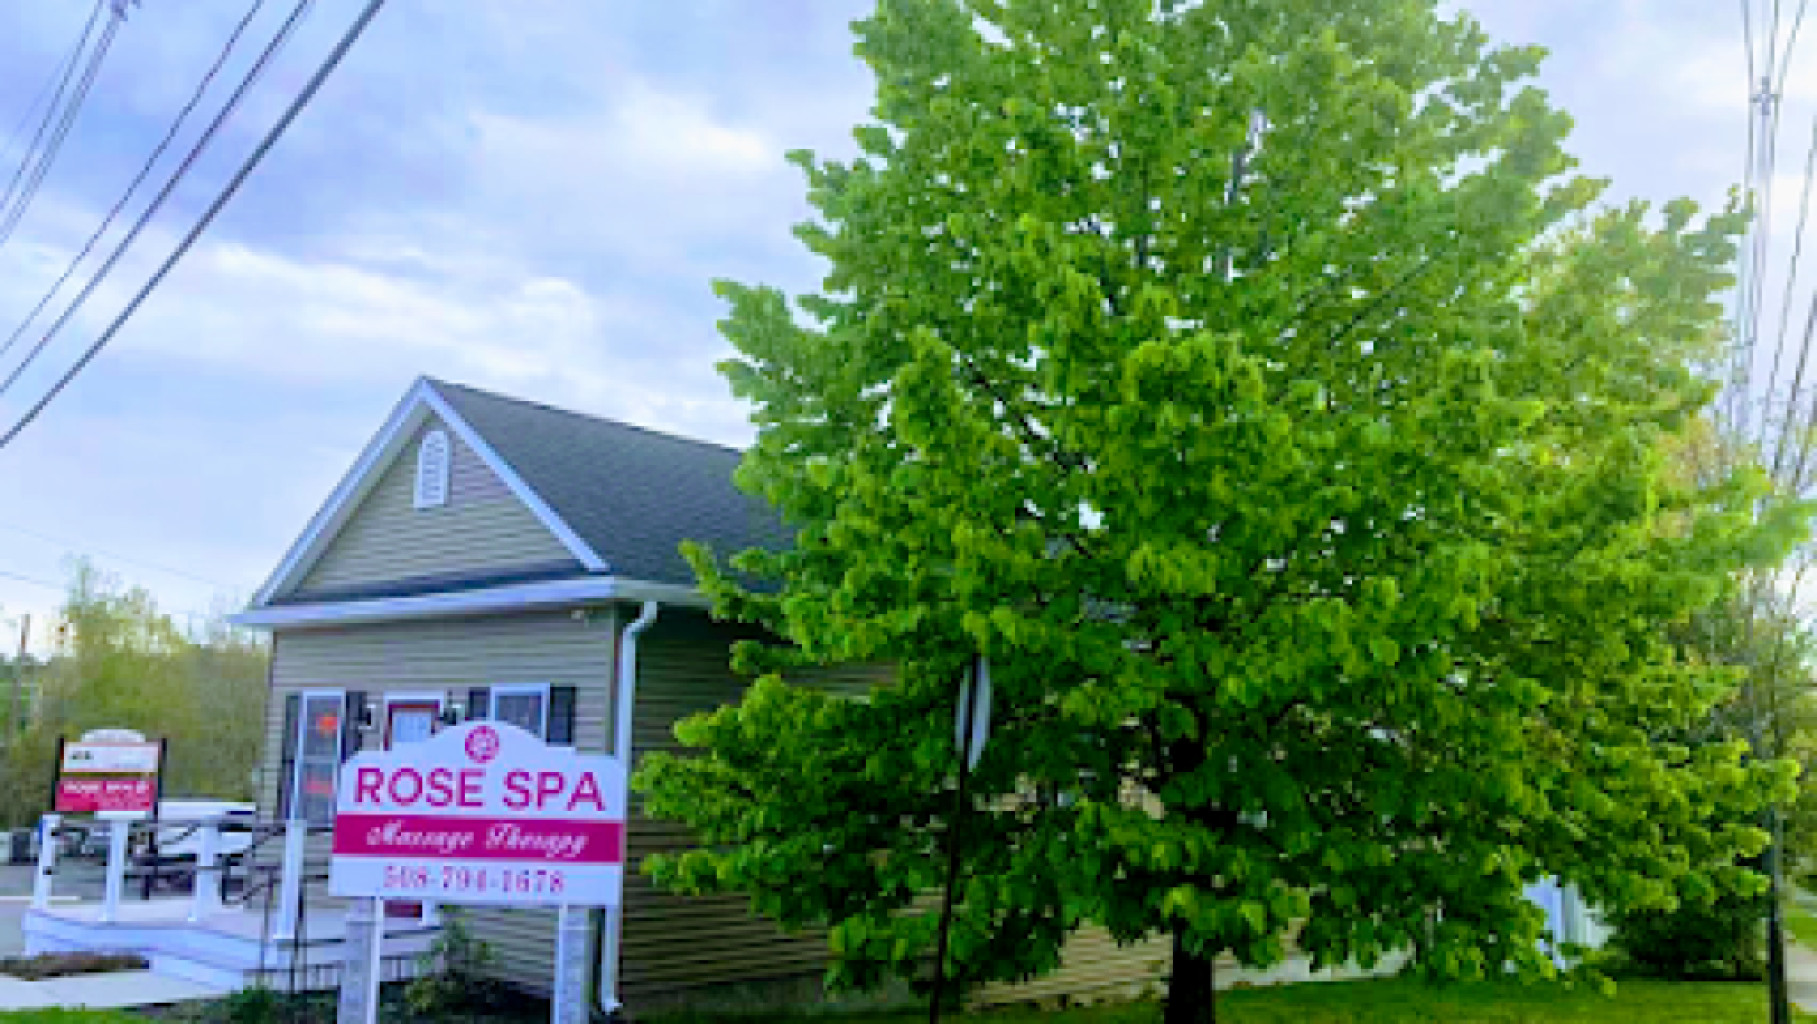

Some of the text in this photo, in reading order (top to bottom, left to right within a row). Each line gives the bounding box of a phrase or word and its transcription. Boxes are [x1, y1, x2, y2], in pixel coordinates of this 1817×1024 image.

[354, 767, 486, 807] ROSE
[503, 771, 606, 811] SPA
[366, 819, 589, 858] Massage Therapy
